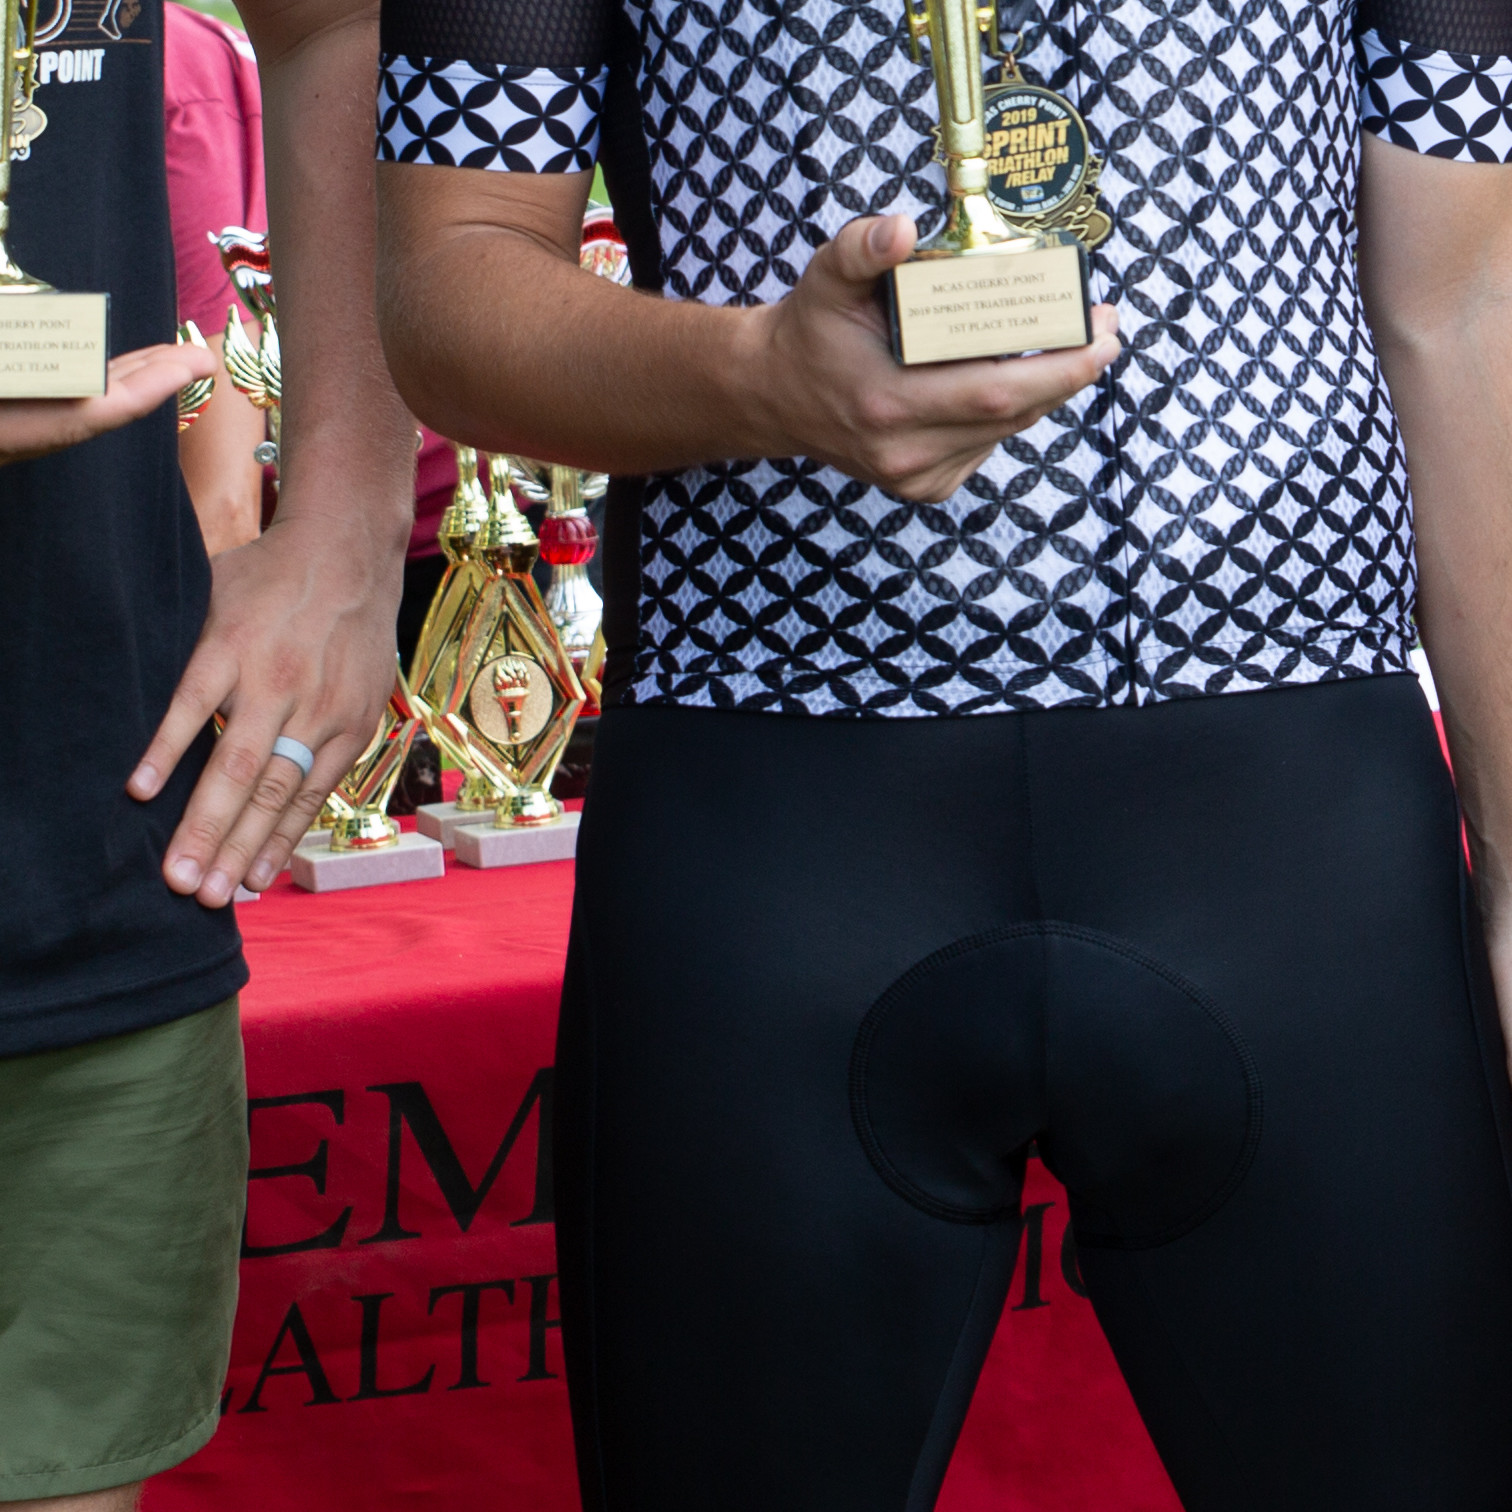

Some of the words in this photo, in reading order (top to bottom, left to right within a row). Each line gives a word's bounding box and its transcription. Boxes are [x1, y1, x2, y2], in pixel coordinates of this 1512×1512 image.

[39, 48, 106, 86] POINT
[1001, 107, 1037, 127] 2019
[987, 146, 1069, 176] RIATHLON
[1005, 166, 1056, 189] /RELAY
[931, 281, 964, 293] MCAS
[966, 277, 1009, 291] CHERRY
[1012, 273, 1046, 286] POINT
[932, 301, 971, 314] SPRINT
[973, 295, 1036, 310] TRIATHLON
[1037, 291, 1075, 303] RELAY
[969, 319, 1003, 332] PLACE
[1007, 316, 1039, 327] TEAM
